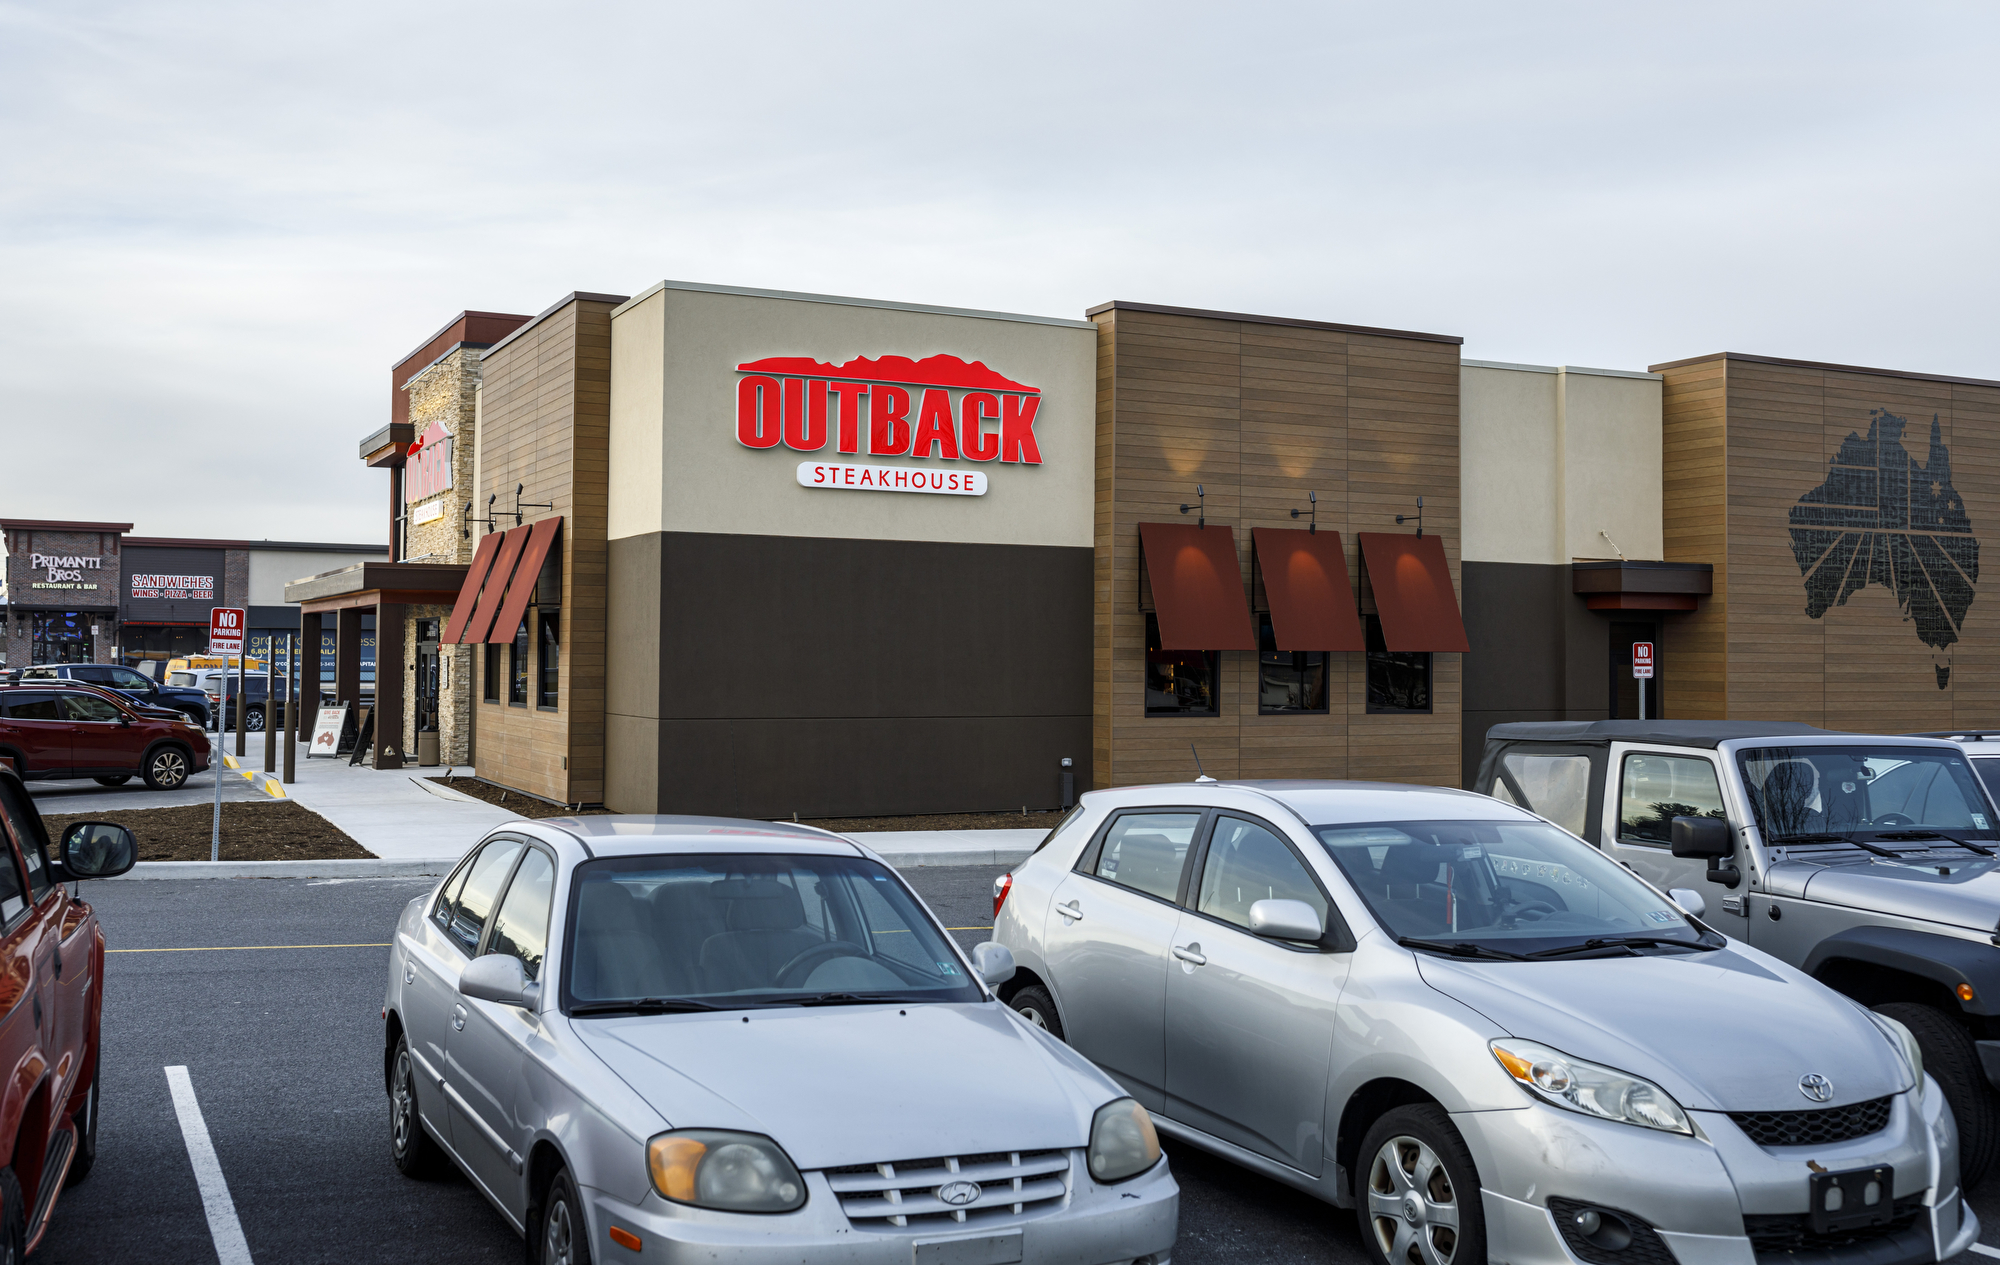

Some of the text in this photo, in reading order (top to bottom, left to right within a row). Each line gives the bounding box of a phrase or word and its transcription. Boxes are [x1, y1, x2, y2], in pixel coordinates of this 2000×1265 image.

[736, 375, 1043, 464] OUTBACK
[814, 466, 974, 491] STEAKHOUSE
[30, 553, 101, 570] PRIMANTI
[32, 582, 75, 590] RESTAURANT
[132, 574, 213, 589] SANDWICHES
[132, 588, 213, 599] WINGS PIZZA BEER
[219, 612, 237, 628] NO
[213, 628, 241, 637] PARKING
[212, 642, 225, 650] FIRE
[1637, 646, 1648, 657] NO
